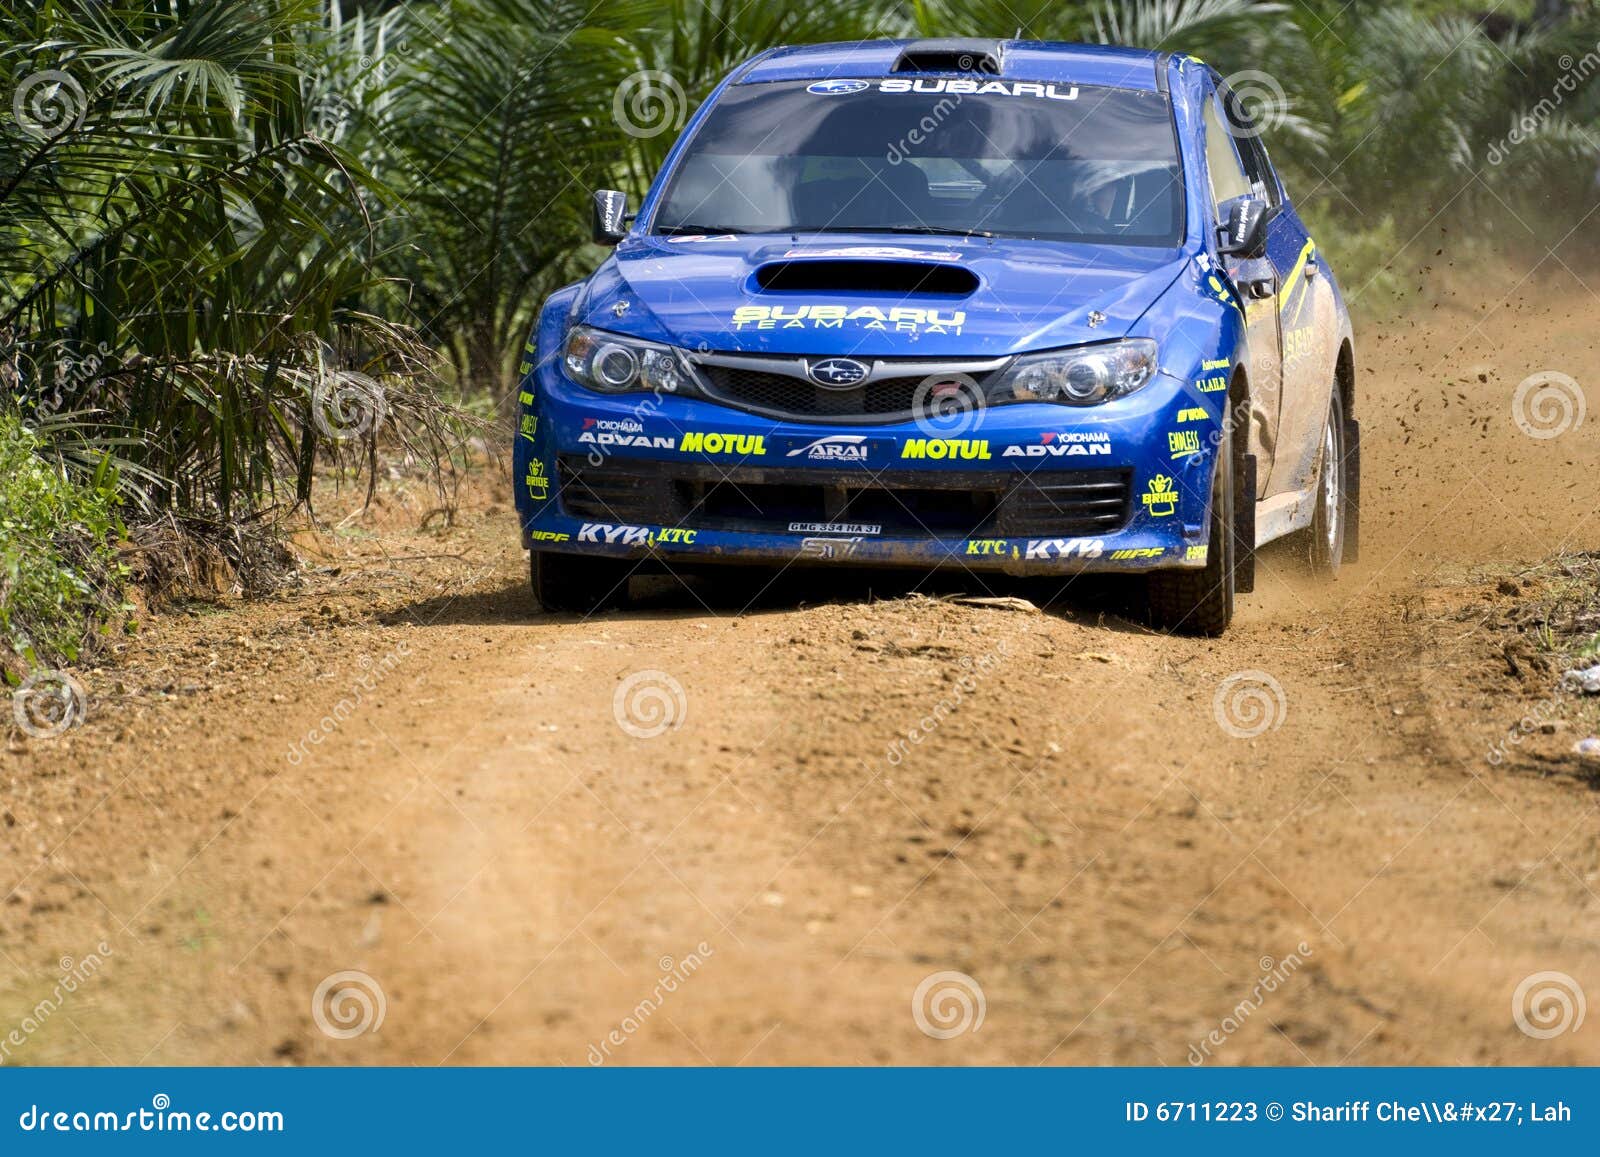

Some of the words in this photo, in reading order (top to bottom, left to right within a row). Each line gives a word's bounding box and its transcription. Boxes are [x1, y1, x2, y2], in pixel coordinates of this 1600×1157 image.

[879, 79, 1079, 100] SUBARU
[732, 305, 967, 326] SUBARU
[732, 319, 845, 330] TEAM
[864, 320, 963, 336] ARAI
[596, 419, 643, 433] YOKOHAMA
[577, 432, 675, 449] ADVAN
[680, 432, 767, 455] MOTUL
[1057, 432, 1110, 443] YOKOHAMA
[809, 445, 867, 457] ARAI
[901, 439, 992, 460] MOTUL
[1002, 443, 1111, 457] ADVAN
[1142, 492, 1179, 504] BRIDE
[656, 527, 697, 544] KTC
[966, 539, 1007, 555] KTC
[1025, 539, 1104, 560] KYB
